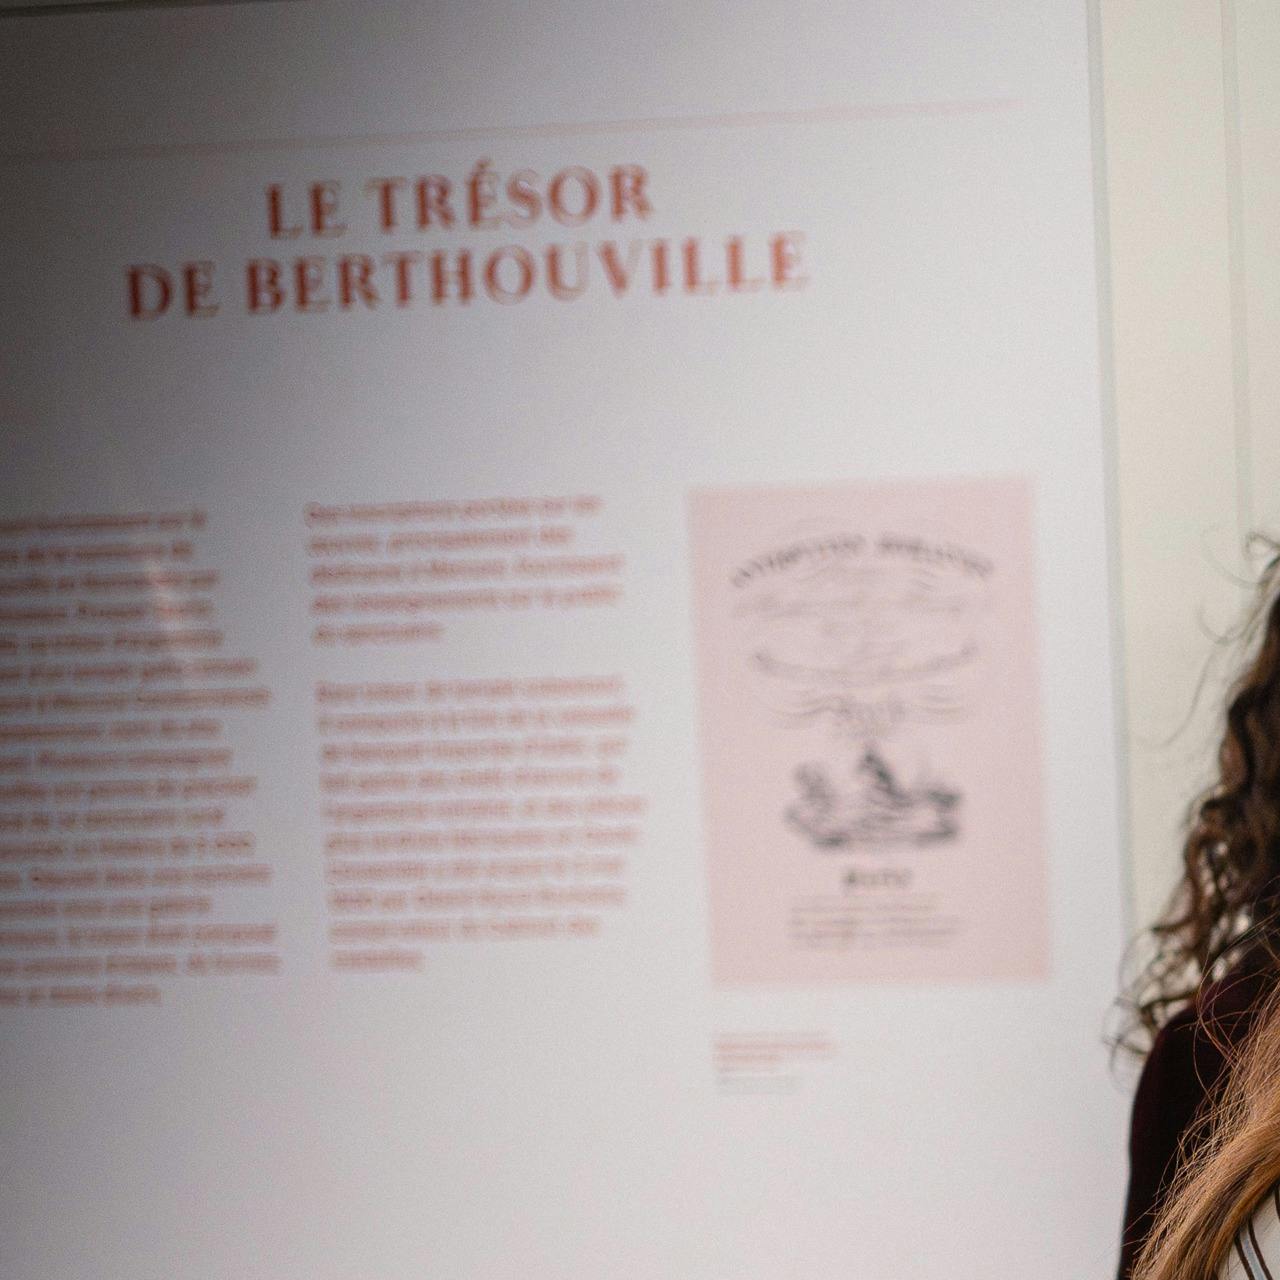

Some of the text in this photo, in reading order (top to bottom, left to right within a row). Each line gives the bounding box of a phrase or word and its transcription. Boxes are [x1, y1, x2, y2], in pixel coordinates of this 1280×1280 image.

[264, 158, 656, 240] LE TRÉSOR
[122, 229, 813, 322] DE BERTHOUVILLE
